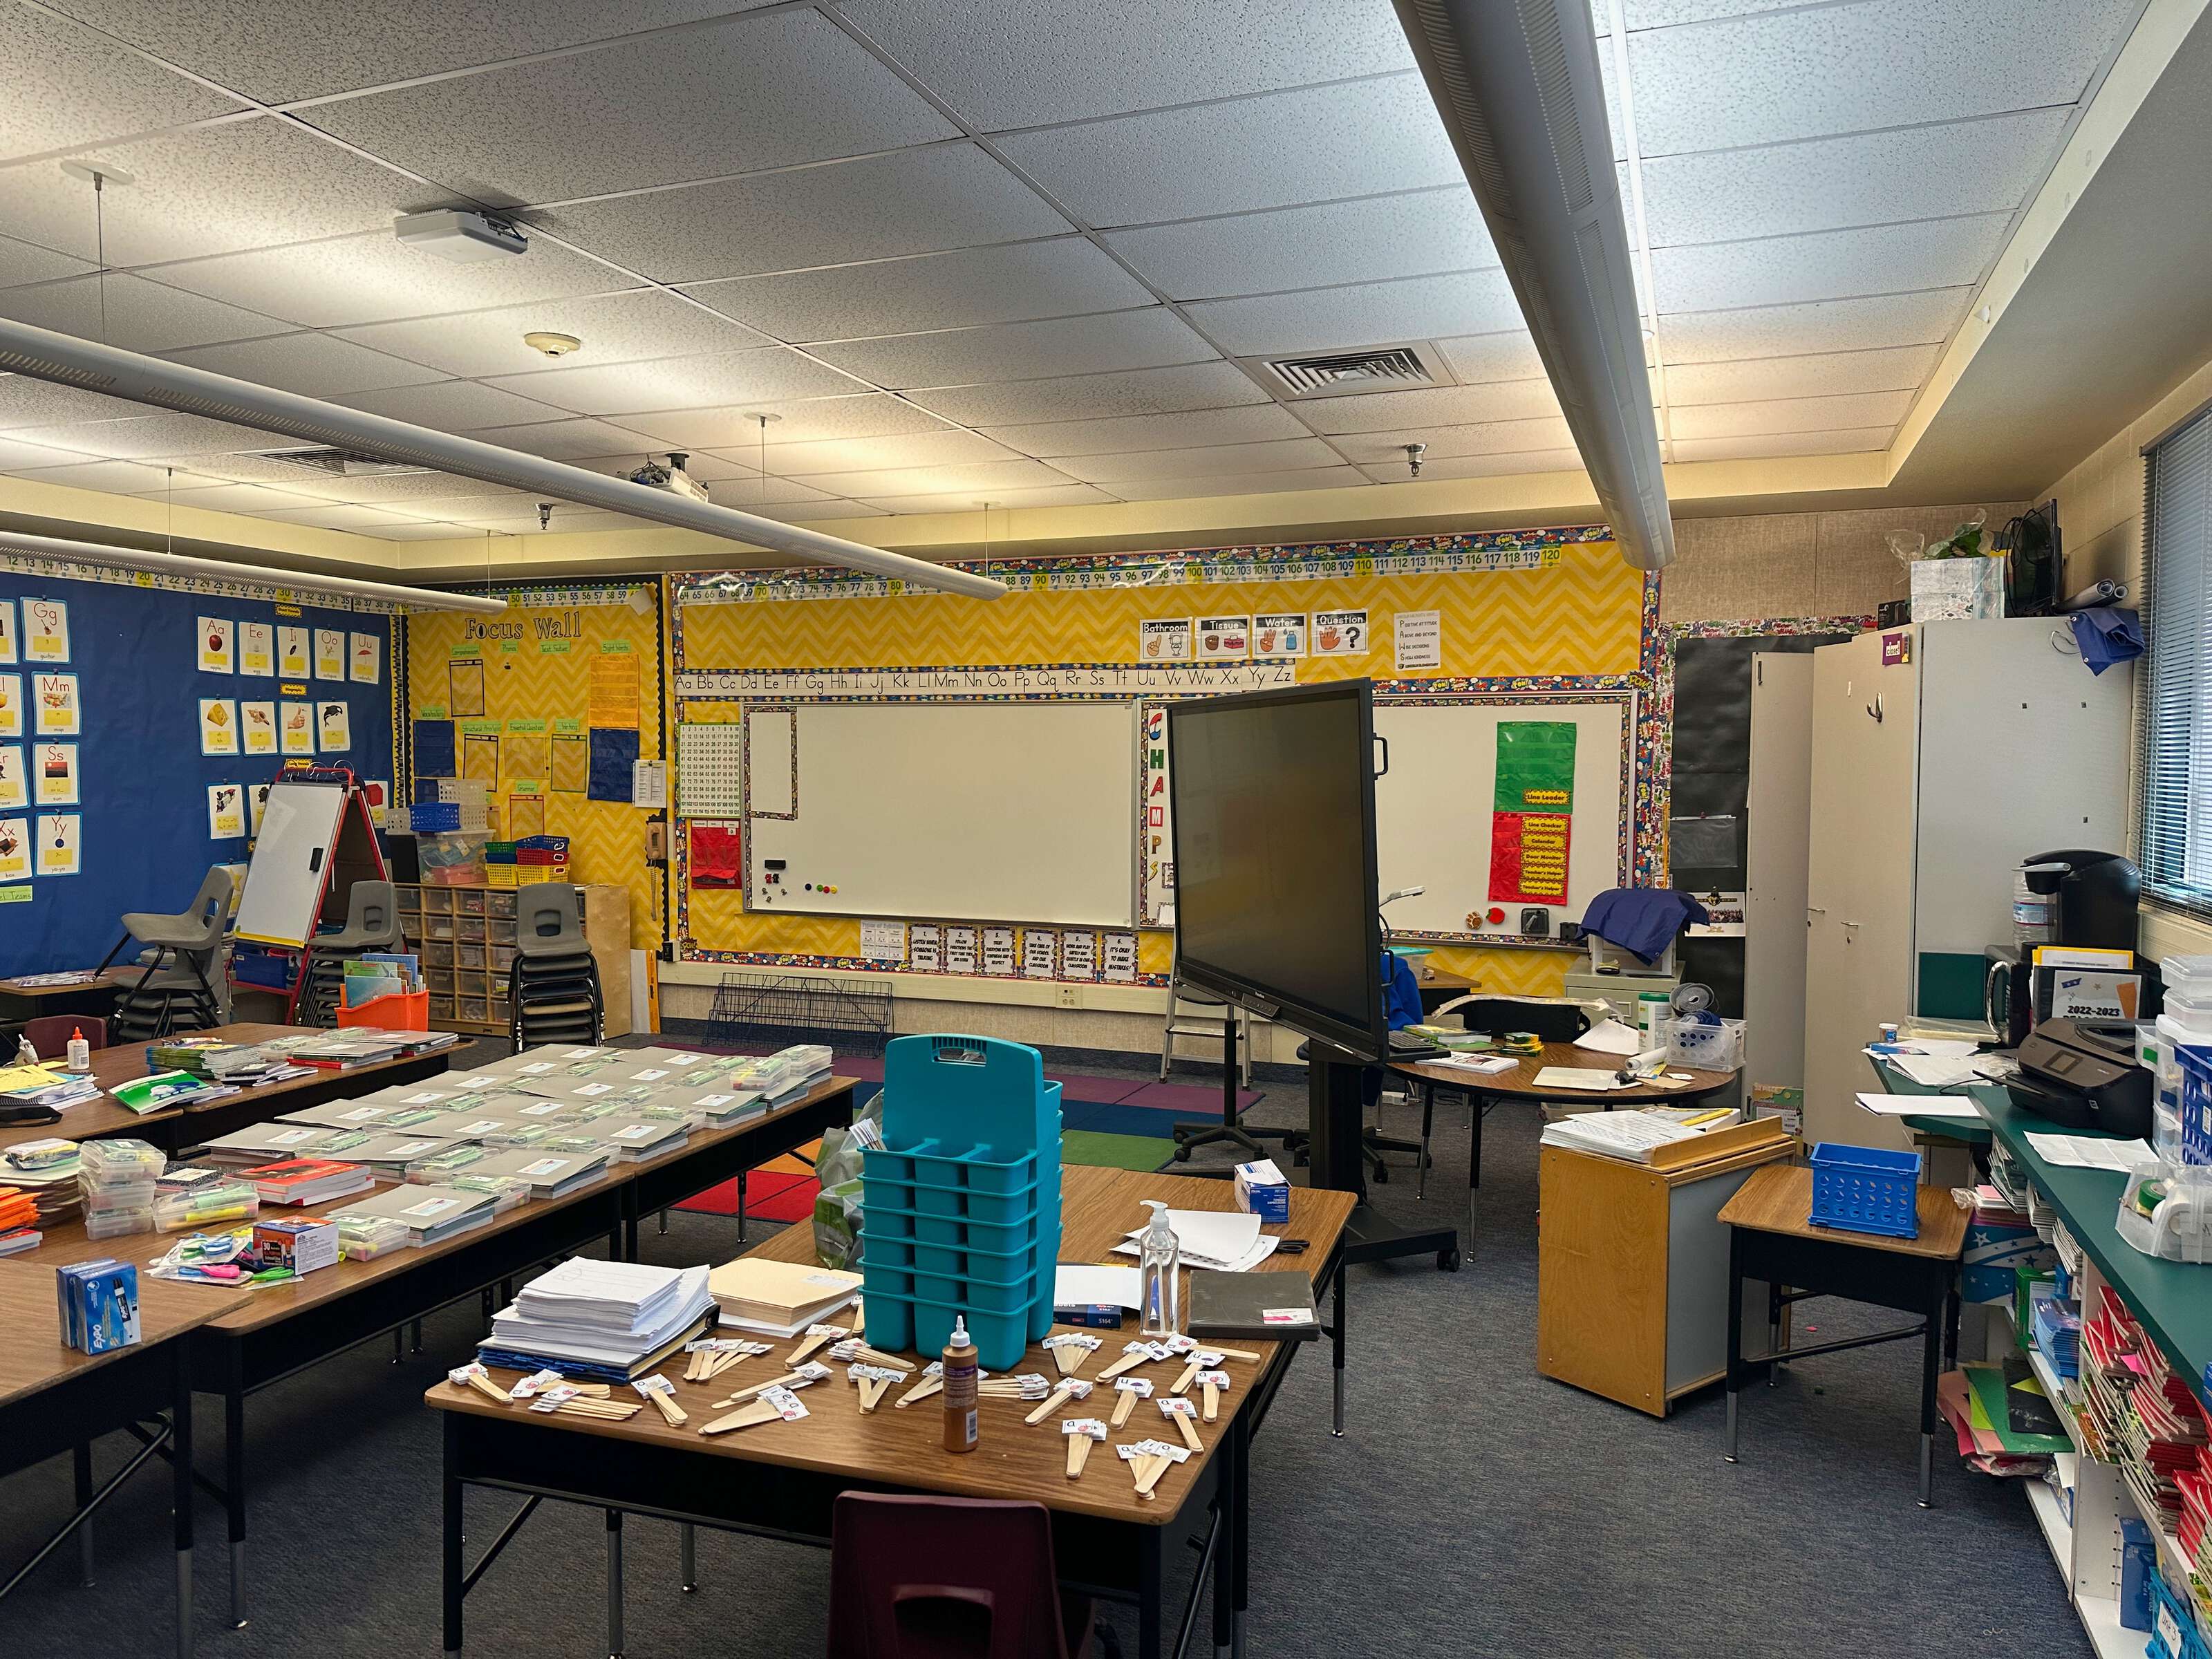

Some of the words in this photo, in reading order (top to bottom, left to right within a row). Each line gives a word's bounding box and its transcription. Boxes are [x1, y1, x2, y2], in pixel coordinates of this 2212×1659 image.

[7, 556, 17, 565] 12
[24, 559, 35, 567] 13
[41, 560, 53, 569] 14
[59, 562, 69, 570] 15
[76, 563, 86, 572] 16
[140, 572, 149, 580] 20
[155, 574, 163, 582] 21
[1006, 577, 1015, 585] 88
[1020, 576, 1031, 584] 89
[1094, 574, 1105, 582] 94
[1271, 565, 1285, 574] 105
[1356, 560, 1371, 569] 110
[1411, 558, 1426, 566] 113
[1447, 556, 1463, 565] 115
[1466, 555, 1481, 564] 116
[1504, 553, 1520, 562] 118
[1523, 552, 1539, 561] 119
[1542, 550, 1559, 559] 120
[582, 592, 590, 600] 56
[34, 603, 57, 626] Gg
[1320, 615, 1364, 624] Question
[207, 620, 224, 635] Aa
[465, 618, 523, 639] Focus
[534, 611, 581, 639] Wall
[1143, 623, 1188, 632] Bathroom
[1210, 621, 1238, 630] Tissue
[1265, 618, 1296, 627] Water
[250, 625, 263, 638] Ee
[290, 628, 297, 641] Ii
[321, 631, 337, 645] Oo
[358, 635, 372, 648] Uu
[44, 677, 69, 691] Mm
[674, 675, 691, 688] Aa
[697, 676, 713, 688] Bb
[720, 675, 735, 688] Cc
[742, 675, 757, 688] Dd
[765, 675, 778, 688] Ee
[787, 675, 799, 688] Ff
[806, 675, 823, 695] Gg
[832, 675, 847, 688] Hh
[855, 675, 862, 688] Ii
[871, 675, 883, 694] Jj
[894, 674, 909, 687] Kk
[919, 673, 930, 687] Ll
[935, 673, 958, 687] Mm
[965, 673, 982, 686] Nn
[988, 673, 1006, 686] Oo
[1015, 672, 1030, 692] Pp
[1038, 671, 1058, 692] Qq
[1066, 671, 1080, 685] Rr
[1090, 671, 1104, 685] Ss
[1113, 671, 1127, 685] Tt
[1138, 671, 1155, 685] Uu
[1165, 671, 1181, 685] Vv
[1188, 670, 1214, 685] Ww
[1221, 670, 1239, 684] Xx
[1249, 667, 1265, 688] Yy
[1274, 666, 1290, 682] Zz
[48, 746, 64, 760] Ss
[52, 817, 66, 838] Yy
[11, 891, 32, 900] Teams
[2068, 1006, 2120, 1016] 2022-2023
